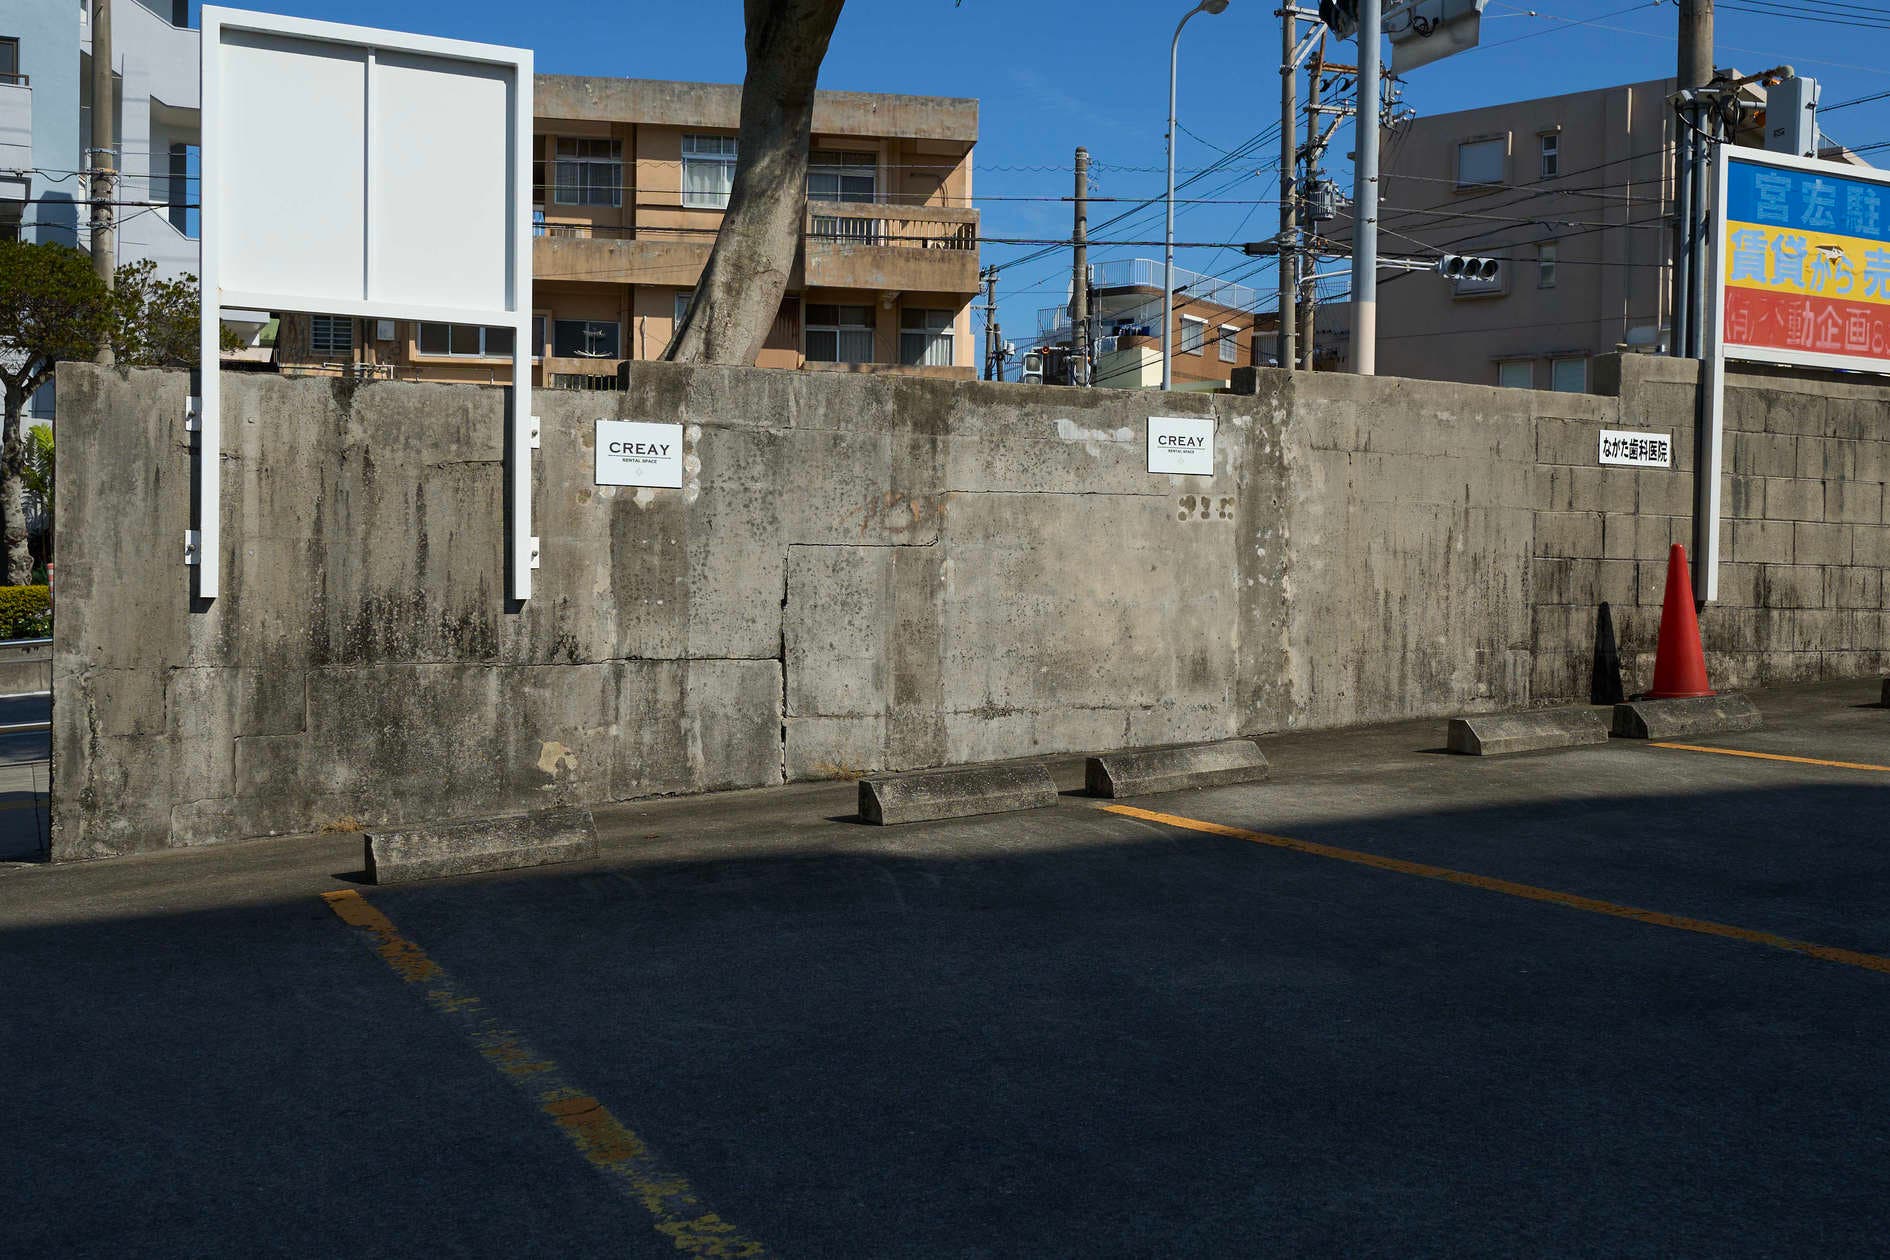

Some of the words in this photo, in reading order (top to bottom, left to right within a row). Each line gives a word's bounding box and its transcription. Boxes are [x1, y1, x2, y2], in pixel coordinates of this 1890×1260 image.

[1755, 171, 1890, 236] 宮宏駐
[609, 442, 670, 456] CREAY
[1158, 435, 1204, 447] CREAY
[1602, 437, 1668, 463] ながた歯科医院
